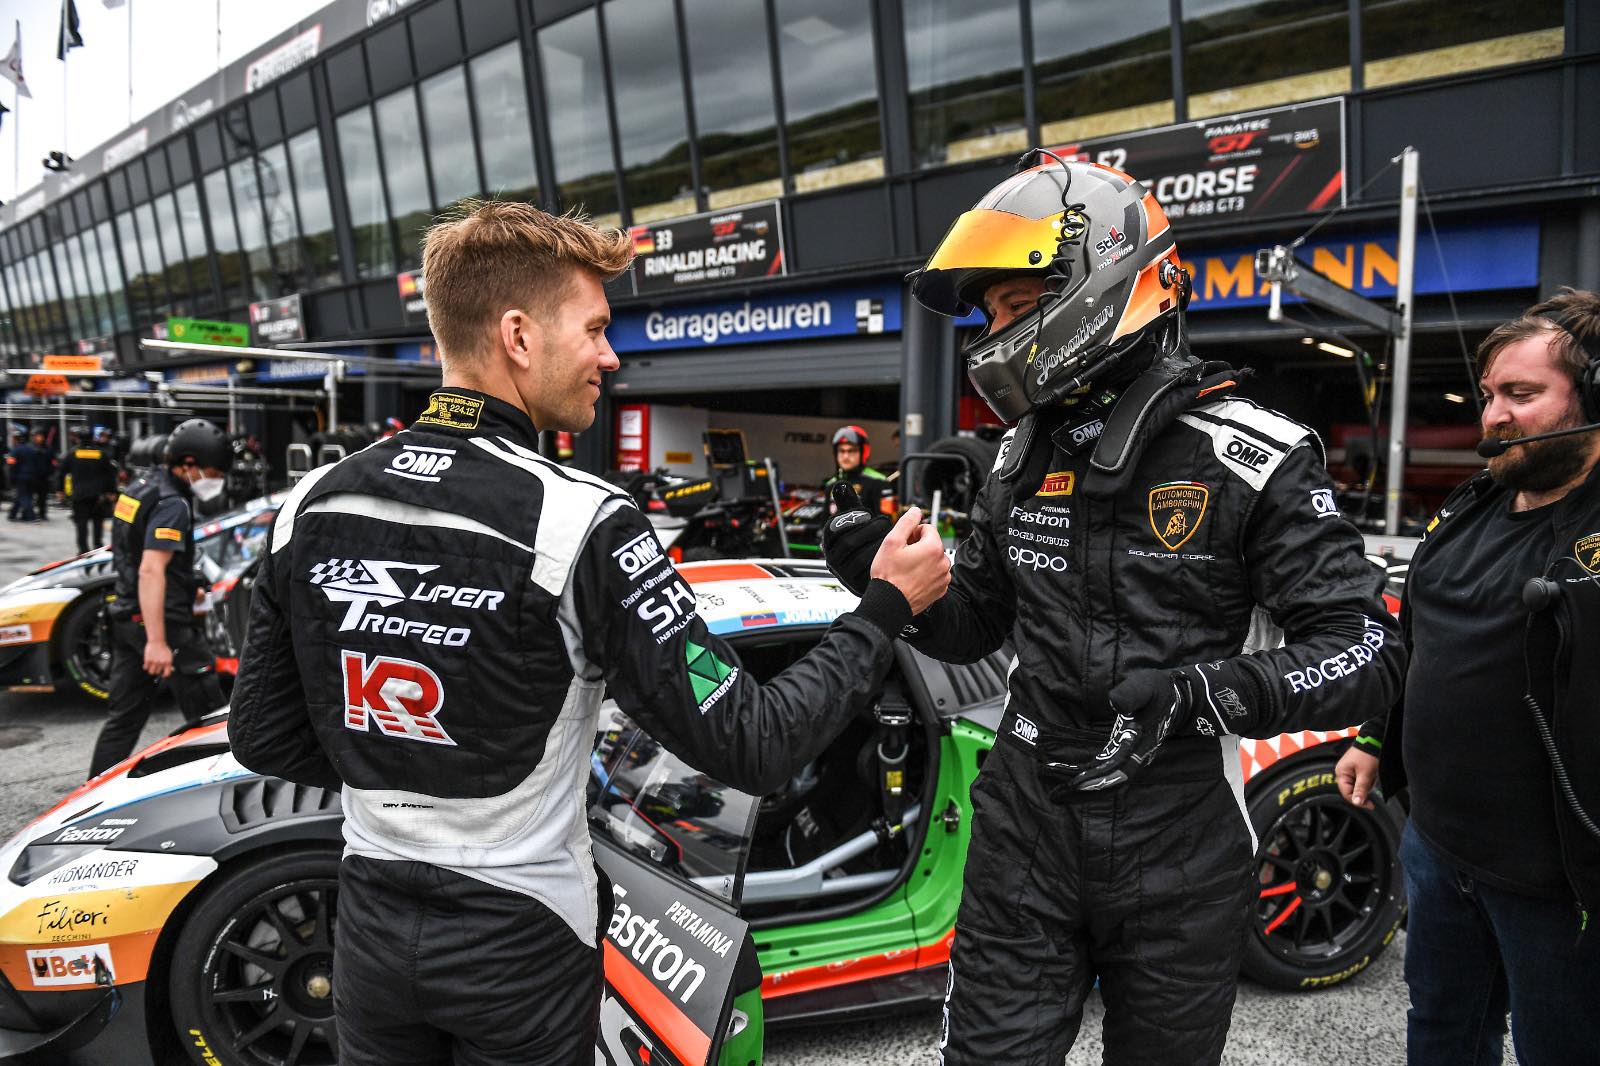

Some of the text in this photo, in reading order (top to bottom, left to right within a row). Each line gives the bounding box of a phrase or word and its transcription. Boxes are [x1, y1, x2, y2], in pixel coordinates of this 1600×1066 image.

[1156, 164, 1257, 204] CORSE
[1216, 196, 1245, 213] GT3
[655, 229, 673, 251] 33
[644, 239, 766, 277] RINALDI RACING
[645, 299, 832, 344] Garagedeuren
[1072, 420, 1104, 443] OMP
[391, 449, 453, 476] OMP
[1225, 440, 1270, 470] OMP
[1153, 499, 1202, 511] LAMBORGHINI
[1156, 489, 1201, 501] AUTOMOBILI
[1010, 506, 1070, 528] Fastron
[1008, 527, 1070, 547] ROGER DUBUIS
[618, 535, 659, 574] OMP
[1008, 545, 1068, 572] oppo
[656, 610, 697, 645] INSTALLAT
[1015, 718, 1040, 741] OMP
[53, 826, 125, 843] Fastron
[36, 900, 111, 934] Filicori
[51, 933, 92, 943] ZECCHINI
[664, 900, 734, 959] PERTAMINA
[50, 954, 97, 978] Bet
